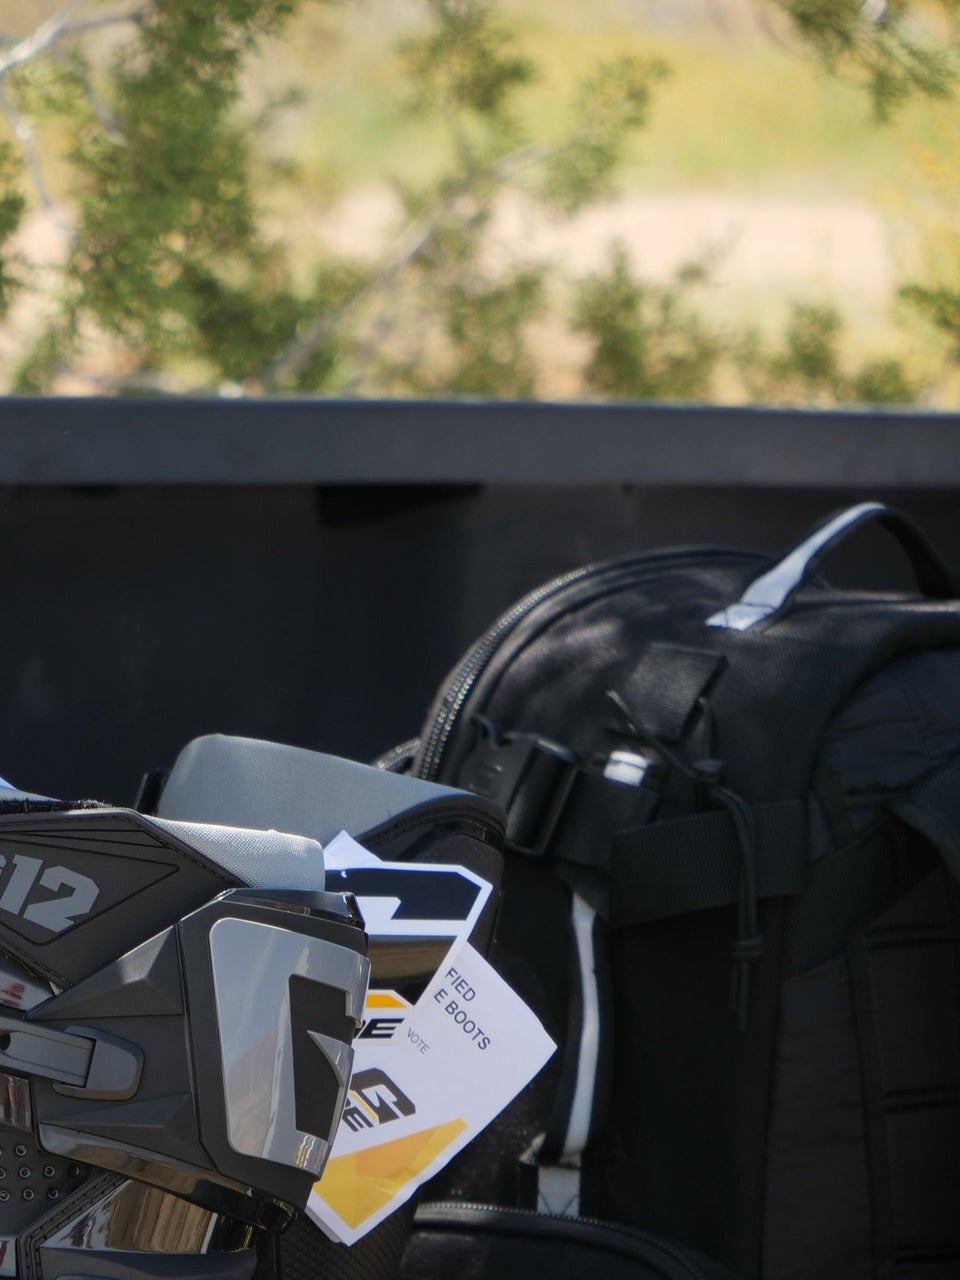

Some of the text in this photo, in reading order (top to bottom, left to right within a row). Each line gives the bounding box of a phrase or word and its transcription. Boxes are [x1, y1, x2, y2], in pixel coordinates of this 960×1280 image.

[445, 967, 476, 1001] FIED
[407, 1027, 430, 1055] VOTE
[445, 1000, 491, 1050] BOOTS
